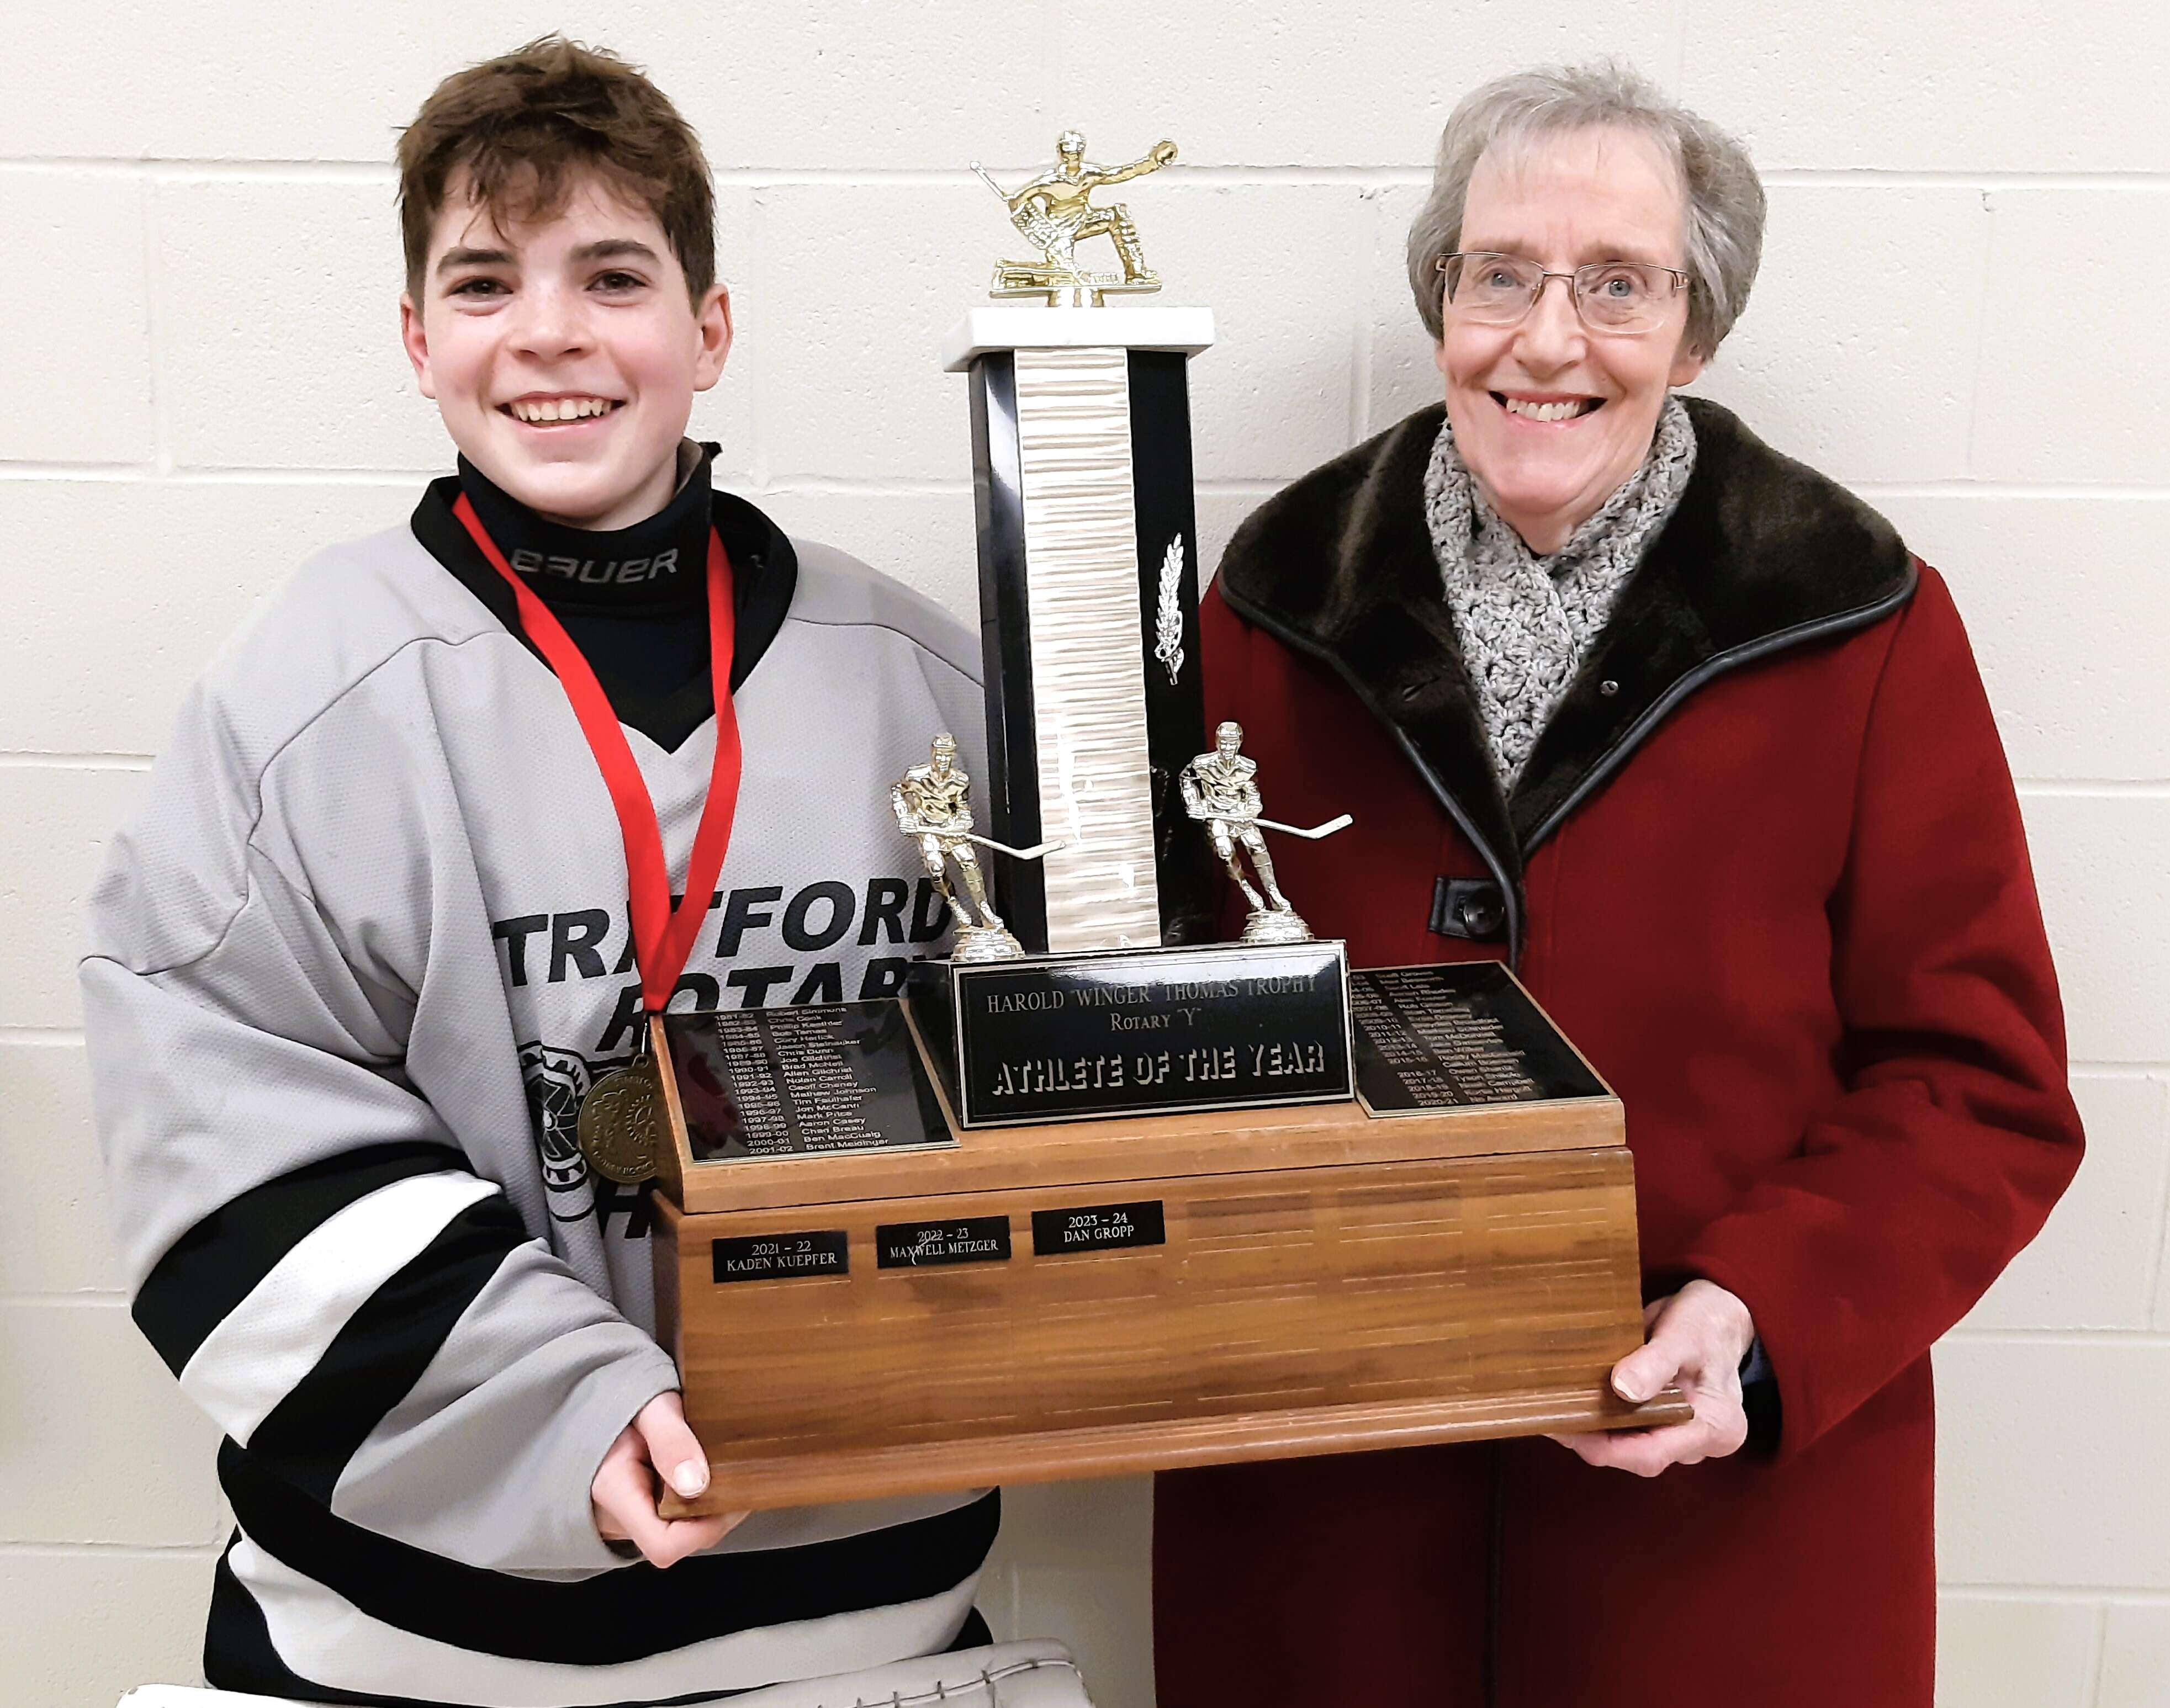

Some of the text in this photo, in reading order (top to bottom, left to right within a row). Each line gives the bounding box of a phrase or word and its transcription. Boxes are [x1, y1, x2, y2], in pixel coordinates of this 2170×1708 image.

[510, 548, 678, 584] BAUER
[987, 990, 1064, 1013] HAROLD
[1165, 982, 1239, 1001] THOMAS
[1248, 977, 1316, 996] TROPHY
[992, 1039, 1325, 1096] ATHLETE OF THE YEAR
[747, 1138, 790, 1146] 2000-01
[749, 1145, 793, 1154] 2001-02
[1068, 1214, 1097, 1229] 2023
[1112, 1212, 1128, 1224] 24
[917, 1229, 944, 1243] 2022
[956, 1227, 969, 1239] 23
[1063, 1225, 1134, 1243] DAN GROPP
[751, 1243, 779, 1256] 2021
[796, 1240, 812, 1253] 22
[890, 1239, 999, 1259] MAXWELL METZGER
[727, 1252, 838, 1271] KADEN KUEPFER
